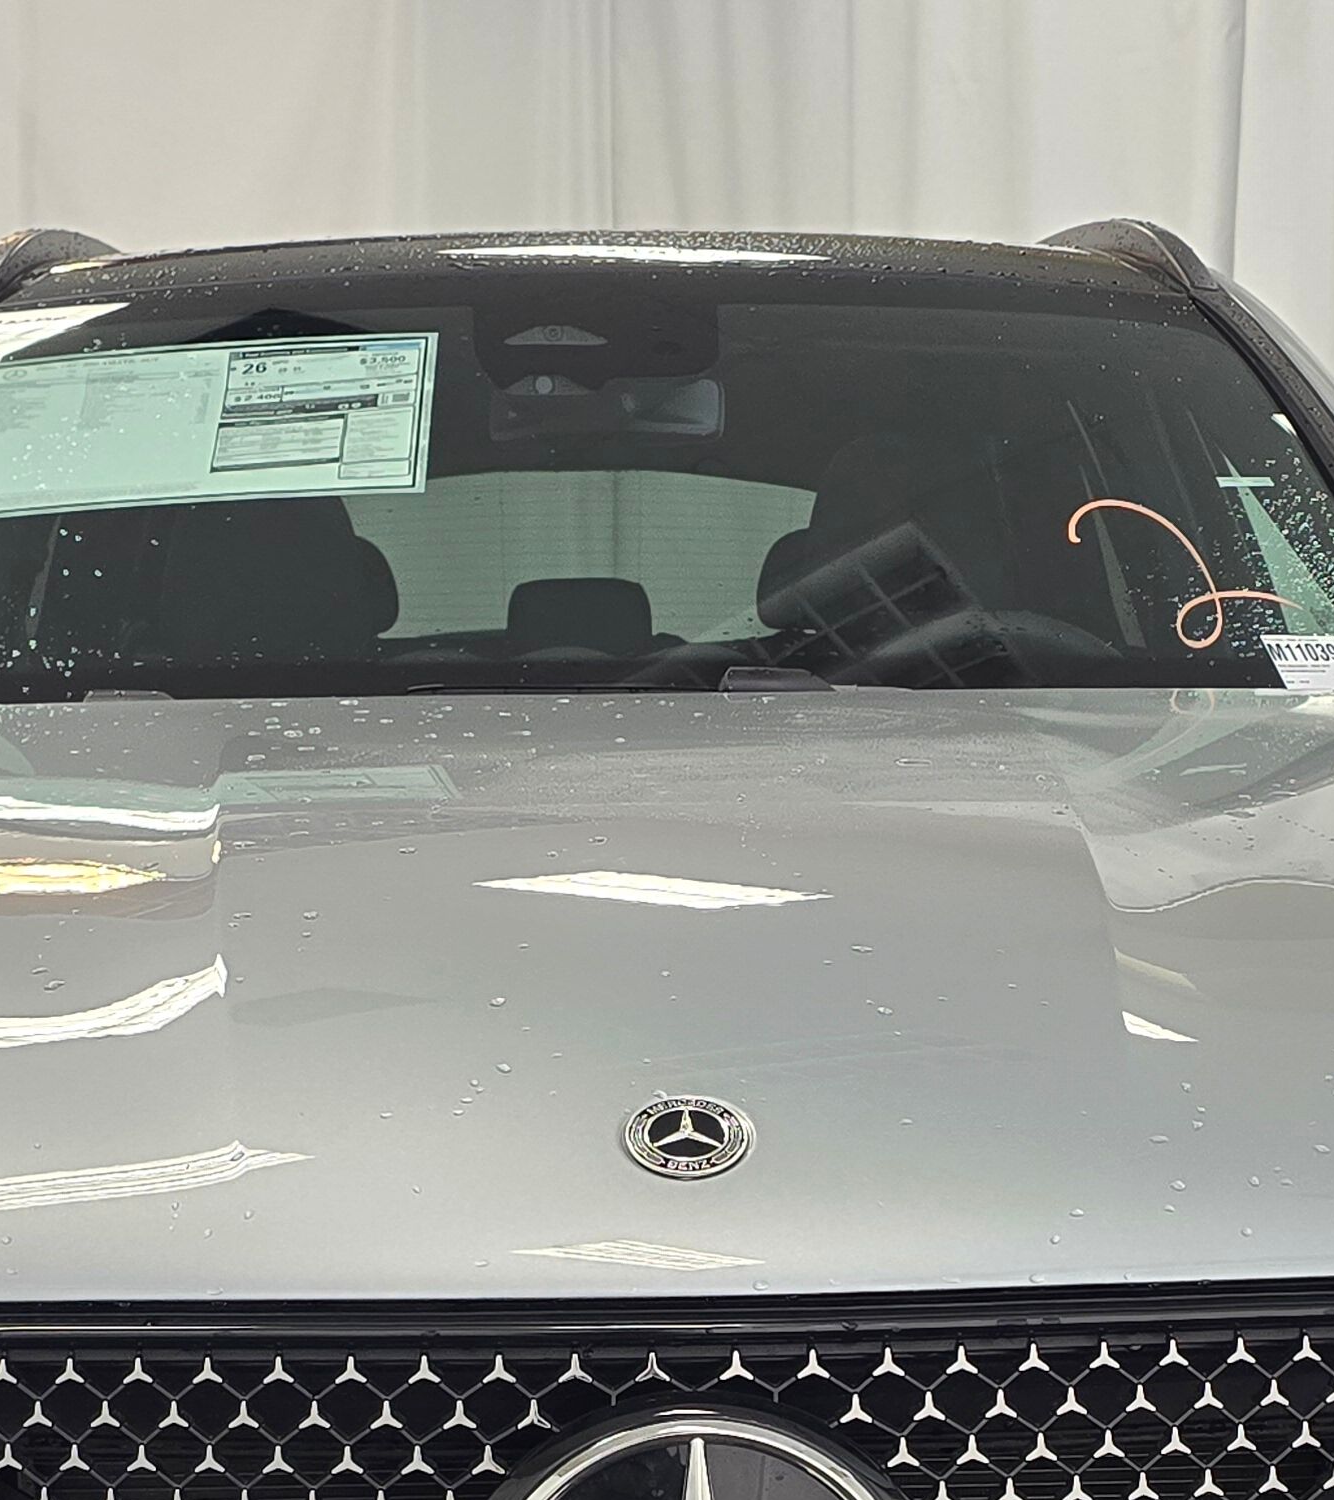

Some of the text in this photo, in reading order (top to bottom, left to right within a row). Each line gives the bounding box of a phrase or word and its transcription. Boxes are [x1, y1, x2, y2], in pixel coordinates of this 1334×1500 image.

[242, 362, 267, 375] 26
[646, 1098, 724, 1115] MERCEDES
[666, 1160, 711, 1171] BENZ
